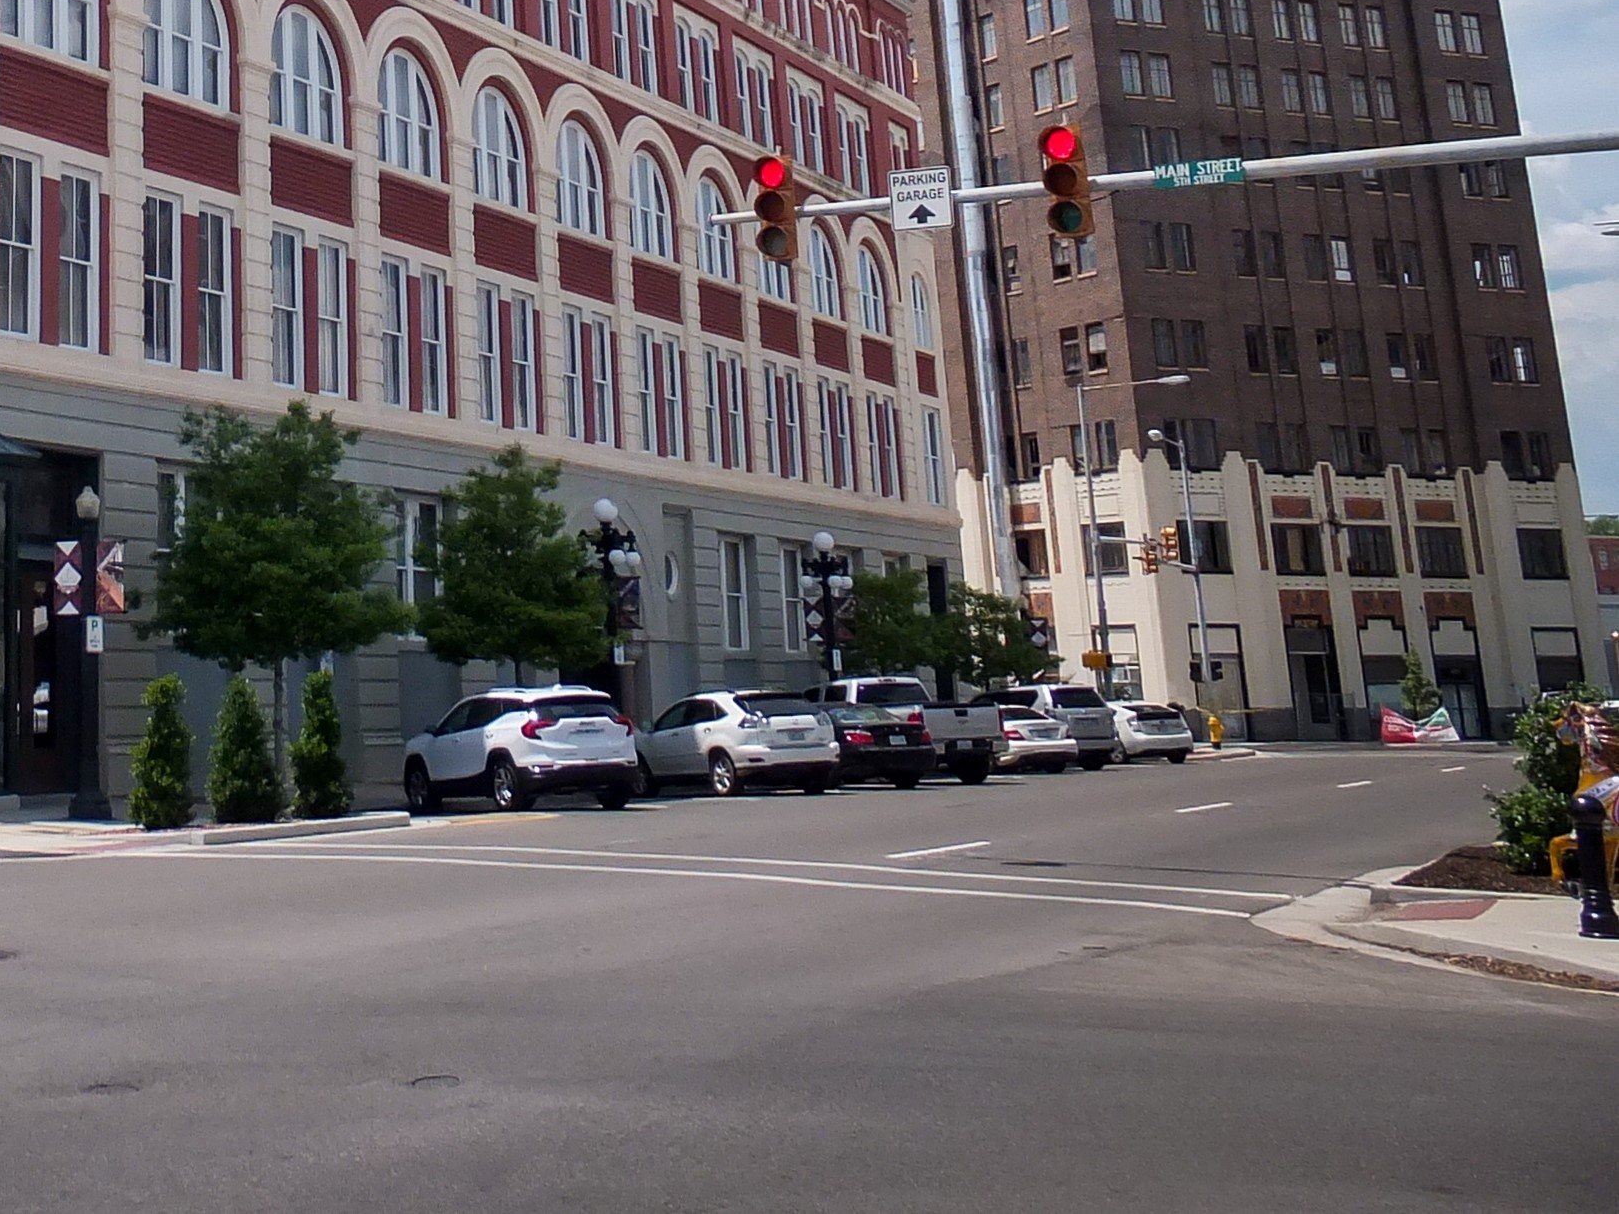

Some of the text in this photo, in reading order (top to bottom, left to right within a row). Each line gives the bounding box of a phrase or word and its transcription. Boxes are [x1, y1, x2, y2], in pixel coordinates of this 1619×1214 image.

[1154, 157, 1242, 179] MAIN STREET
[892, 172, 946, 187] PARKING
[1173, 173, 1225, 187] 5TH STREET
[896, 188, 944, 202] GARAGE
[91, 619, 99, 632] P
